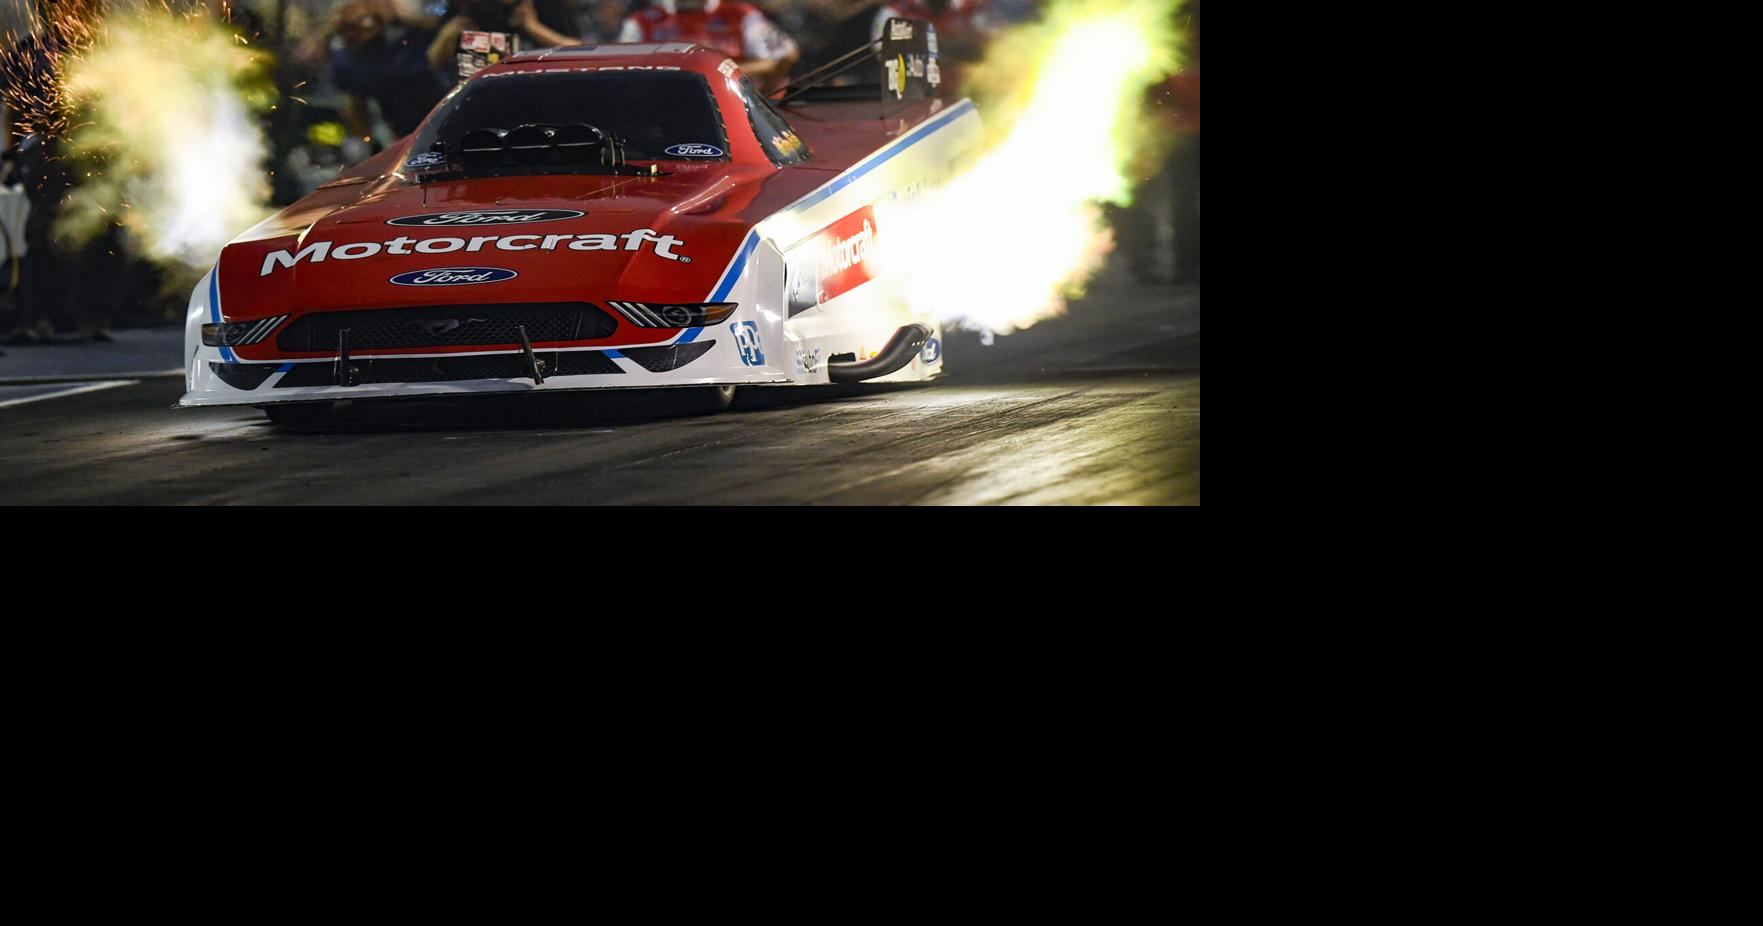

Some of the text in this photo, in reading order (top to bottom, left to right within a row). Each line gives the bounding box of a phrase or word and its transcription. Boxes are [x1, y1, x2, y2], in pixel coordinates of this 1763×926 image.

[677, 145, 714, 157] Ford
[424, 210, 548, 226] Ford
[413, 268, 494, 285] Ford
